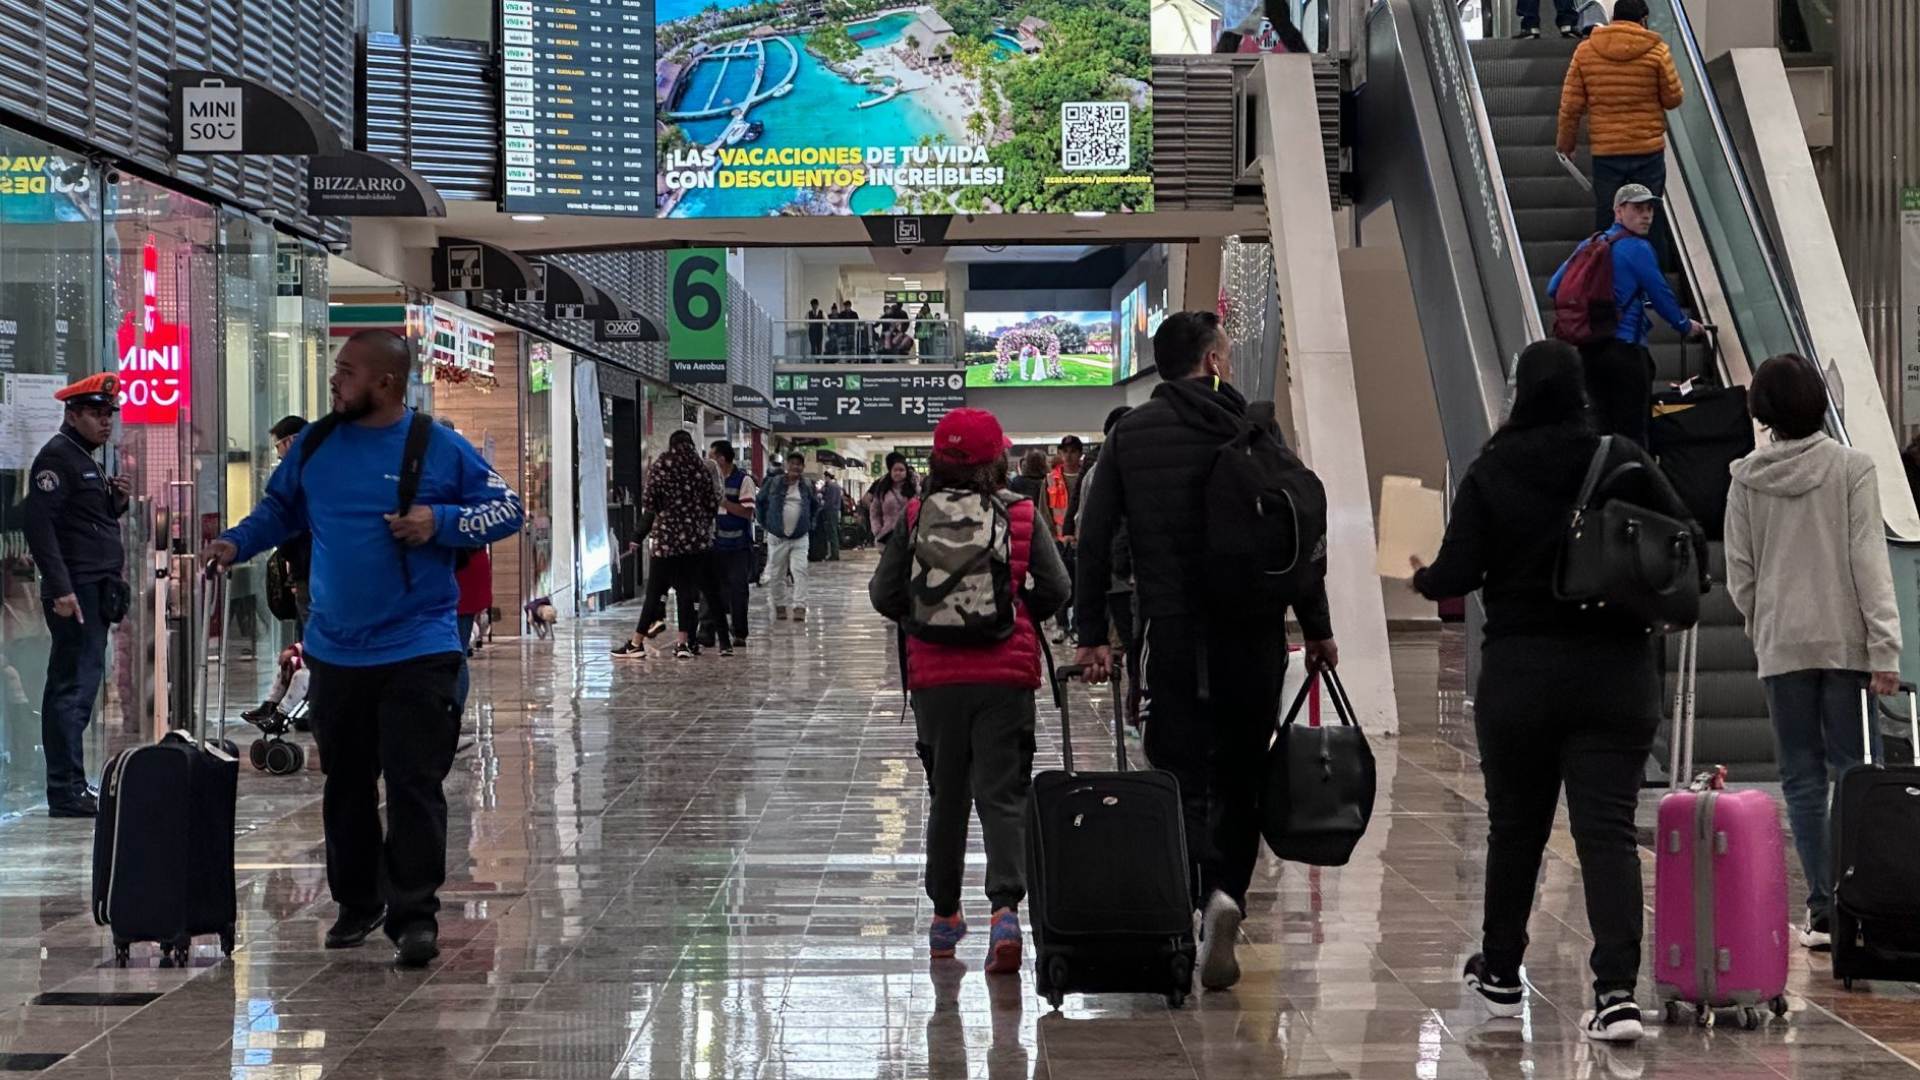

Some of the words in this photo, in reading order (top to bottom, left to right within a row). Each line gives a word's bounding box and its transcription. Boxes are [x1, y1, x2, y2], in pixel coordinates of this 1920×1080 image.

[190, 100, 236, 118] MINI
[665, 148, 717, 172] ¡LAS
[719, 147, 863, 166] VACACIONES
[866, 146, 896, 164] DE
[899, 146, 934, 164] TU
[934, 145, 990, 163] VIDA
[313, 177, 406, 192] BIZZARRO
[665, 171, 714, 189] CON
[719, 168, 866, 188] DESCUENTOS
[869, 164, 1005, 186] INCREÍBLES!
[673, 255, 722, 331] 6
[606, 321, 639, 334] OXXO
[118, 345, 180, 371] MINI
[674, 361, 692, 371] Viva
[692, 361, 726, 371] Aerobus
[822, 377, 844, 388] G-J
[912, 377, 946, 388] F1-F3
[836, 396, 862, 416] F2
[900, 396, 926, 415] F3
